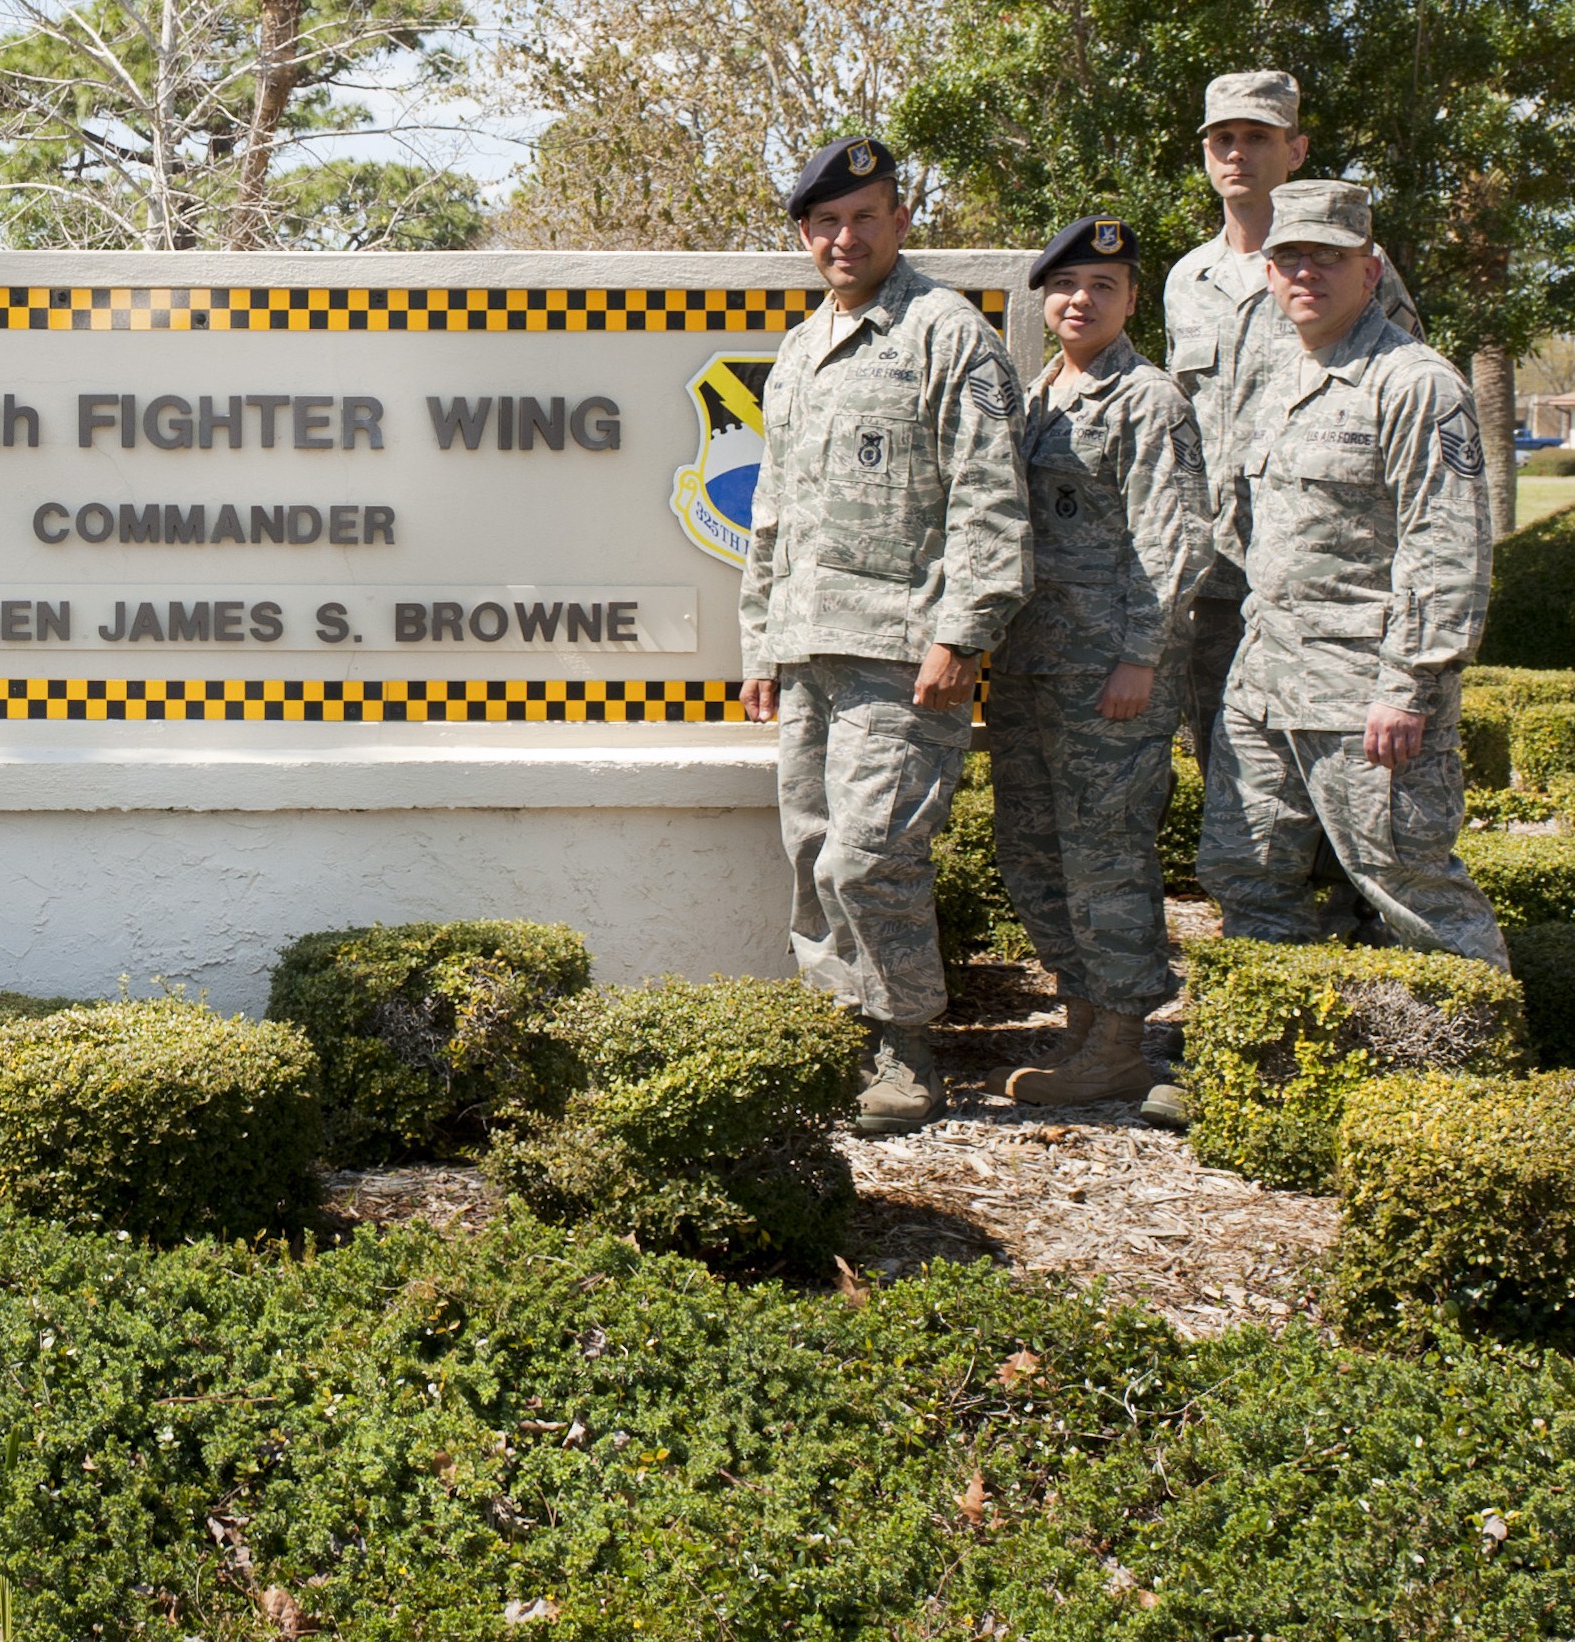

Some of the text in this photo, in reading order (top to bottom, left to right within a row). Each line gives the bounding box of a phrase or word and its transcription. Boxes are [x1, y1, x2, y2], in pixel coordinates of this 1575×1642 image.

[884, 368, 915, 382] FORCE
[78, 394, 385, 450] FIGHTER
[426, 395, 622, 451] WING
[1337, 431, 1372, 446] FORCE
[33, 502, 396, 545] COMMANDER
[695, 500, 741, 552] 325TH
[98, 601, 284, 643] JAMES
[316, 602, 363, 644] S.
[395, 601, 638, 643] BROWNE
